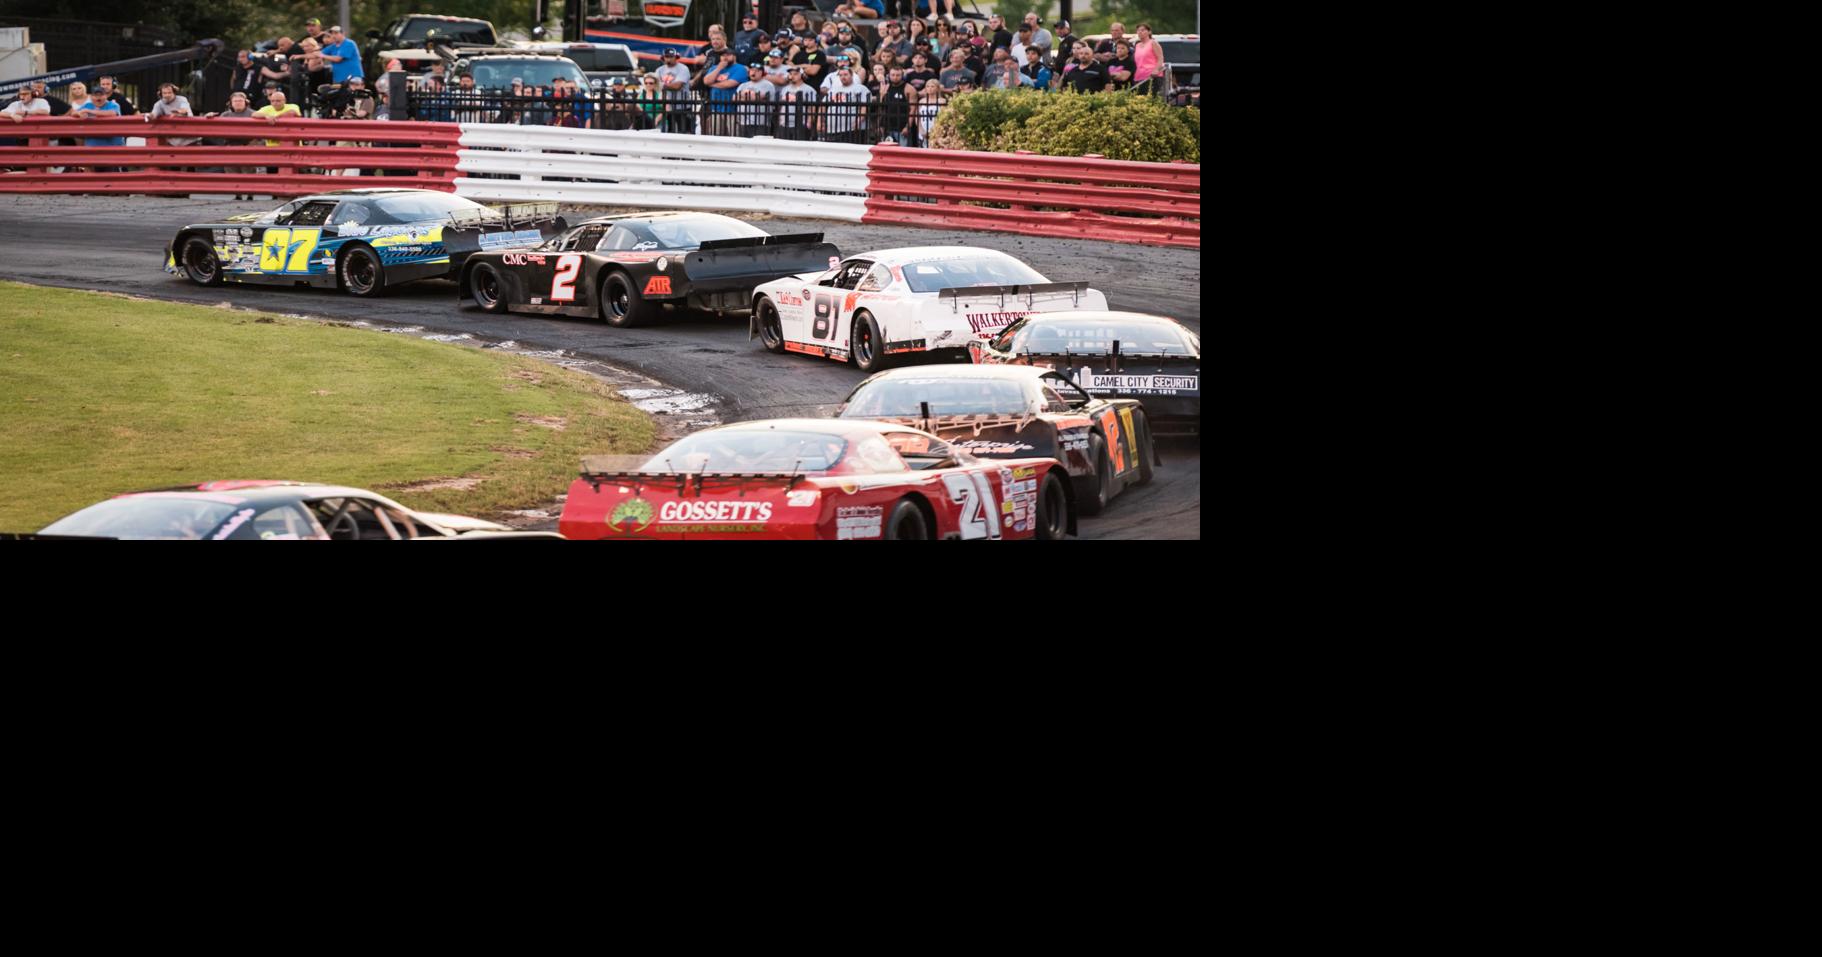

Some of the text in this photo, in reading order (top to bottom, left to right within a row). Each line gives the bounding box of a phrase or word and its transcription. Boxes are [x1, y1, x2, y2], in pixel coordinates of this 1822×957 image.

[502, 253, 528, 266] CMC
[550, 253, 583, 302] 2
[812, 293, 842, 341] 81
[1094, 376, 1195, 389] CAMEL CITY SECURITY
[660, 501, 773, 521] GOSSETT'S
[941, 471, 1002, 540] 21
